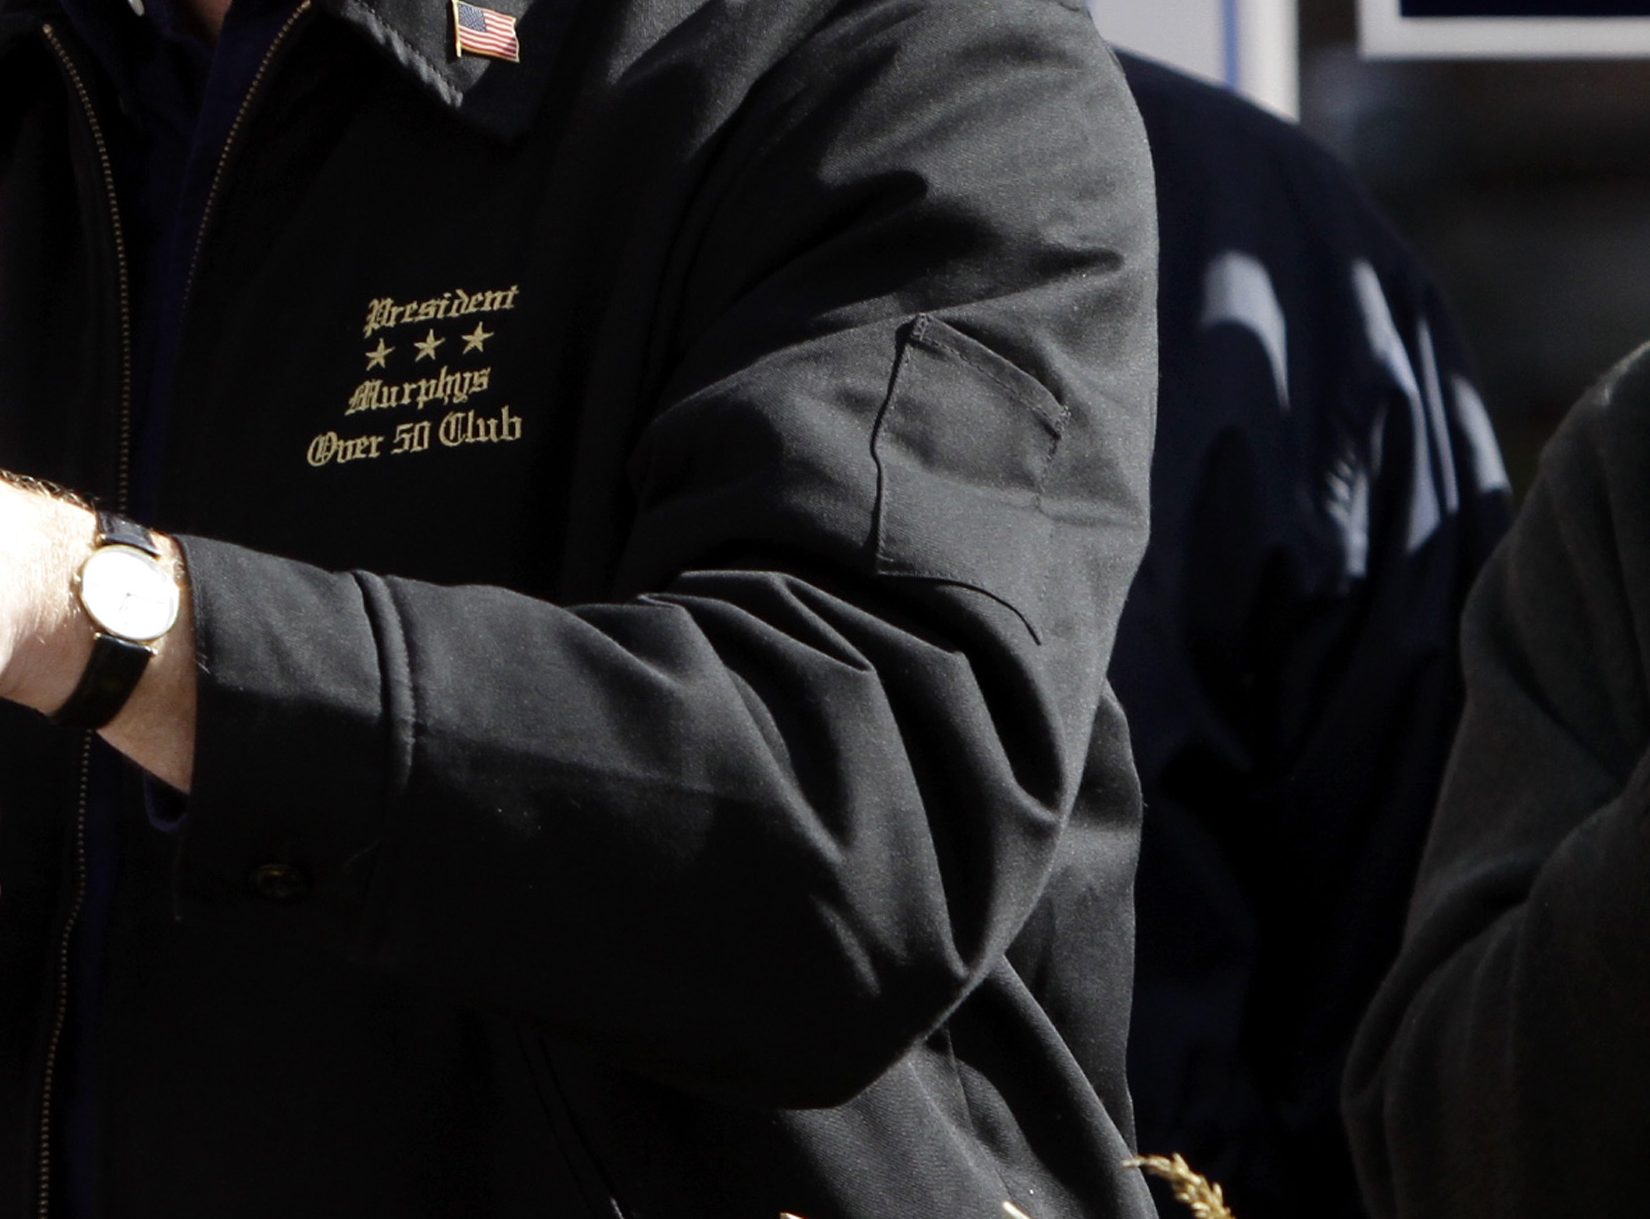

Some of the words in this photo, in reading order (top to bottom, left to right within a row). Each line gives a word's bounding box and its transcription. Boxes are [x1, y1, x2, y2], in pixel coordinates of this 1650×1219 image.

[363, 285, 518, 338] President
[345, 366, 491, 416] Murphys
[307, 431, 384, 467] Over
[391, 420, 431, 454] 50
[438, 405, 523, 447] Club
